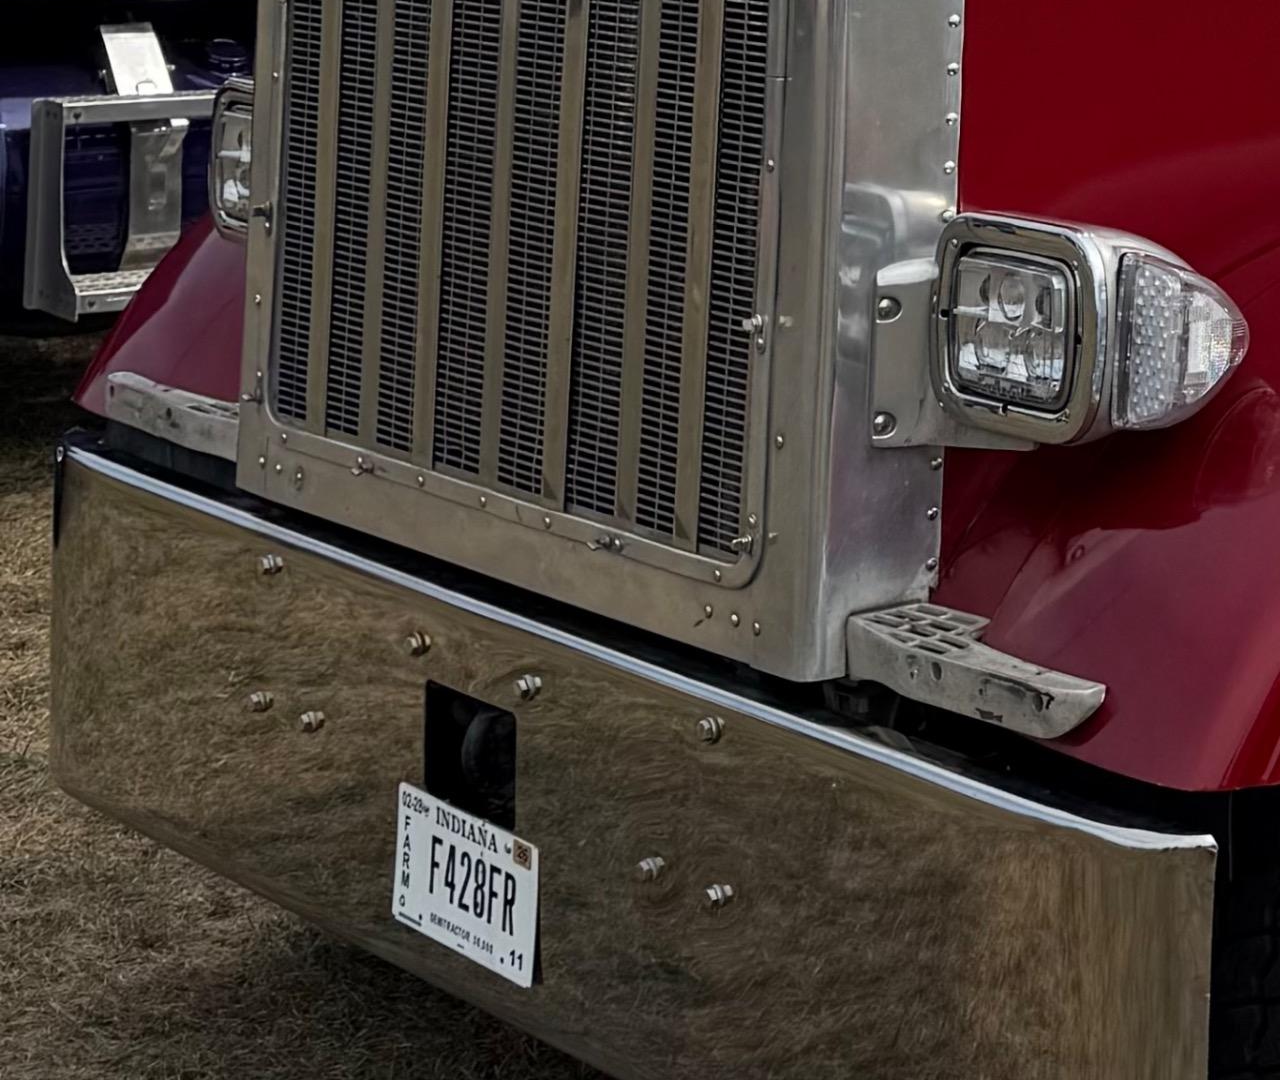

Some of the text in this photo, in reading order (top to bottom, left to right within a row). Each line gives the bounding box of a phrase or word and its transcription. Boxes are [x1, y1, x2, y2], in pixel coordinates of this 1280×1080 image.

[401, 815, 412, 889] FARM
[436, 806, 498, 854] INDIANA
[429, 835, 517, 936] F428FR
[508, 949, 524, 973] 11
